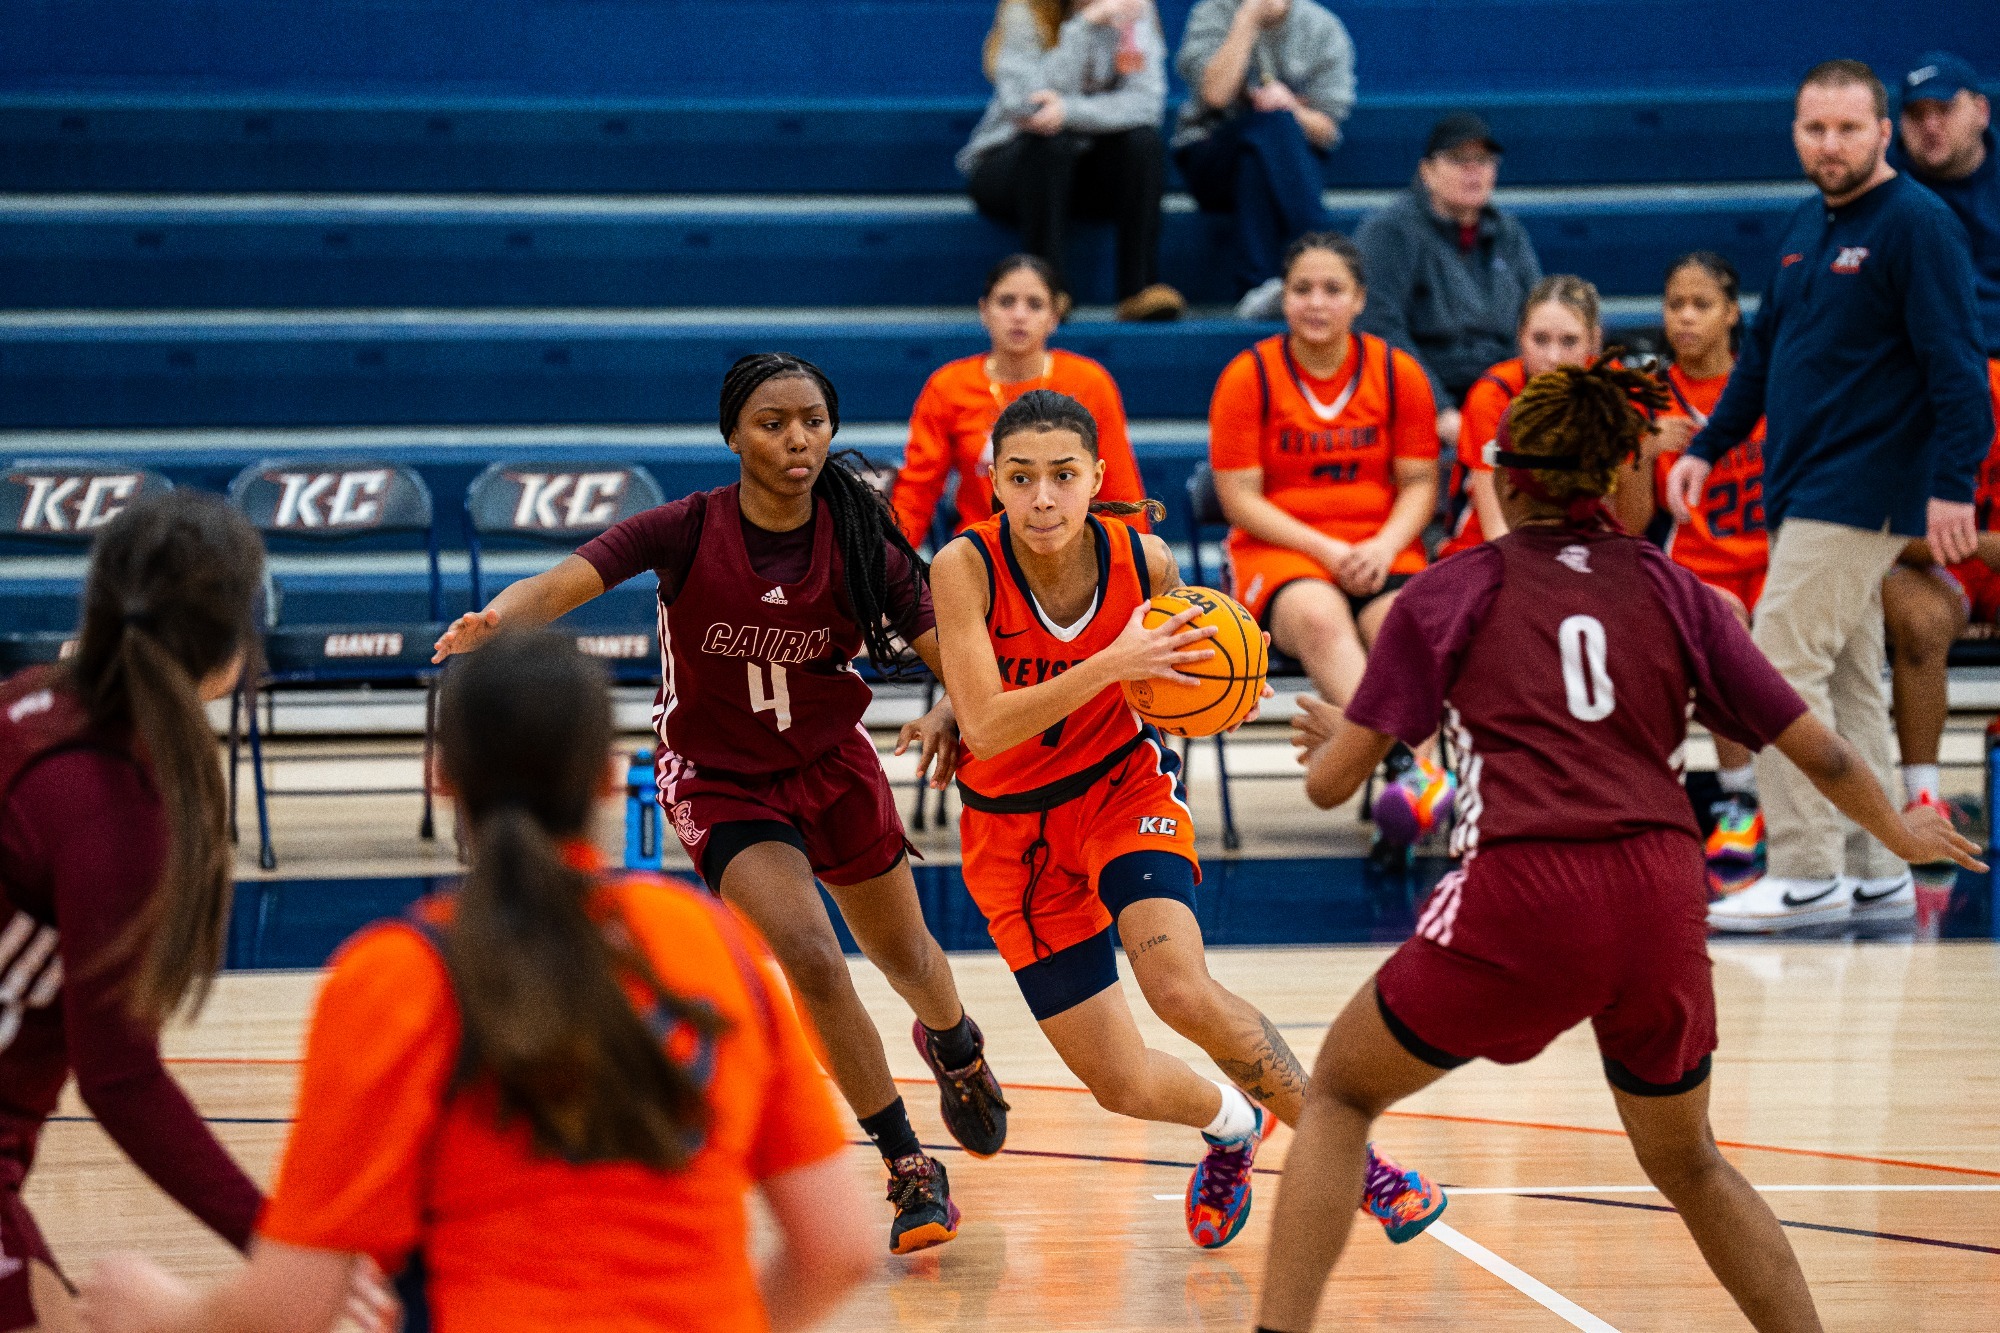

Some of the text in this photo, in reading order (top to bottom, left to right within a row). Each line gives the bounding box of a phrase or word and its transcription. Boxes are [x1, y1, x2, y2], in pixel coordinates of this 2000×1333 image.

[20, 474, 139, 531] KC
[272, 470, 393, 530] KC
[512, 471, 629, 530] KC
[761, 595, 788, 605] adidas
[325, 633, 402, 657] GIANTS
[702, 622, 830, 664] CAIRN
[997, 655, 1086, 687] KEYS
[1558, 614, 1616, 722] 0
[747, 661, 792, 732] 4
[1138, 815, 1178, 836] KC
